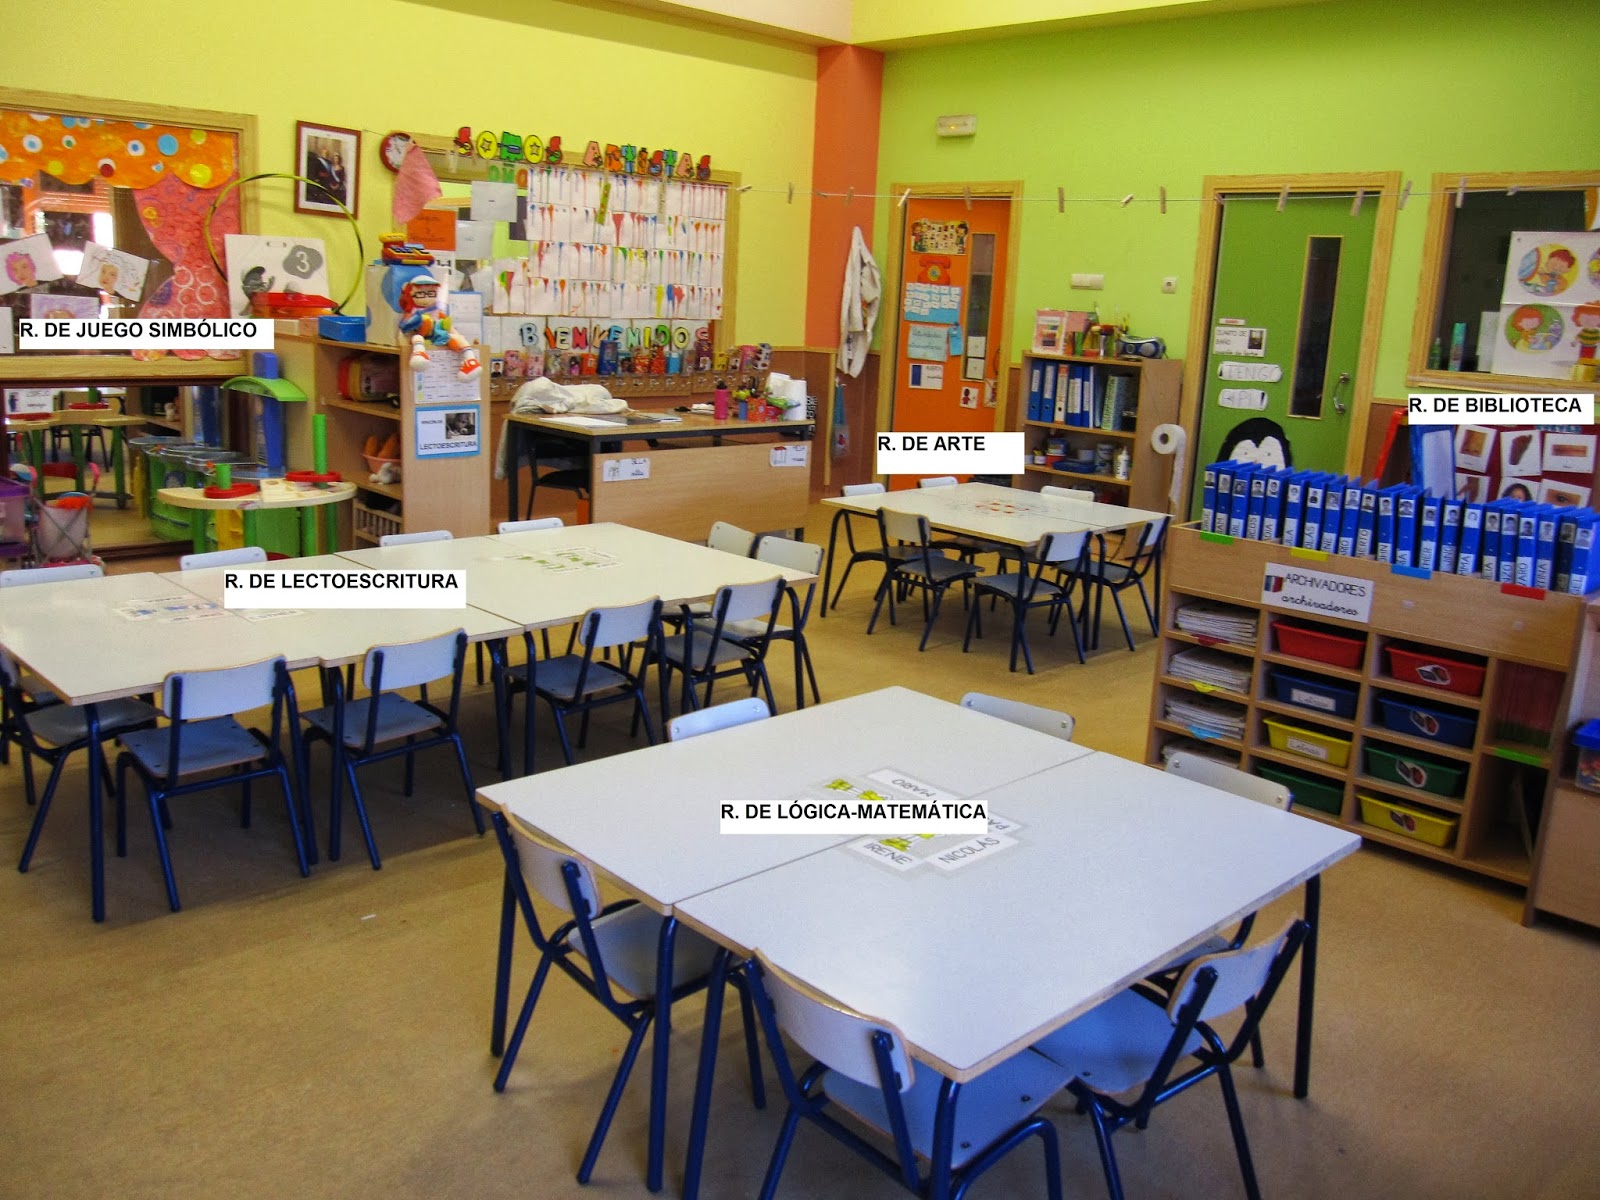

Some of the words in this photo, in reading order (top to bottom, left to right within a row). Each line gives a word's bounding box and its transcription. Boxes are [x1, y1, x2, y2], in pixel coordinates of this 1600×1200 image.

[454, 126, 562, 164] SOMOS
[582, 140, 711, 180] ARTISTAS
[296, 251, 310, 273] 3
[1284, 573, 1366, 597] ARCHIVADORES
[863, 842, 913, 865] IRENE
